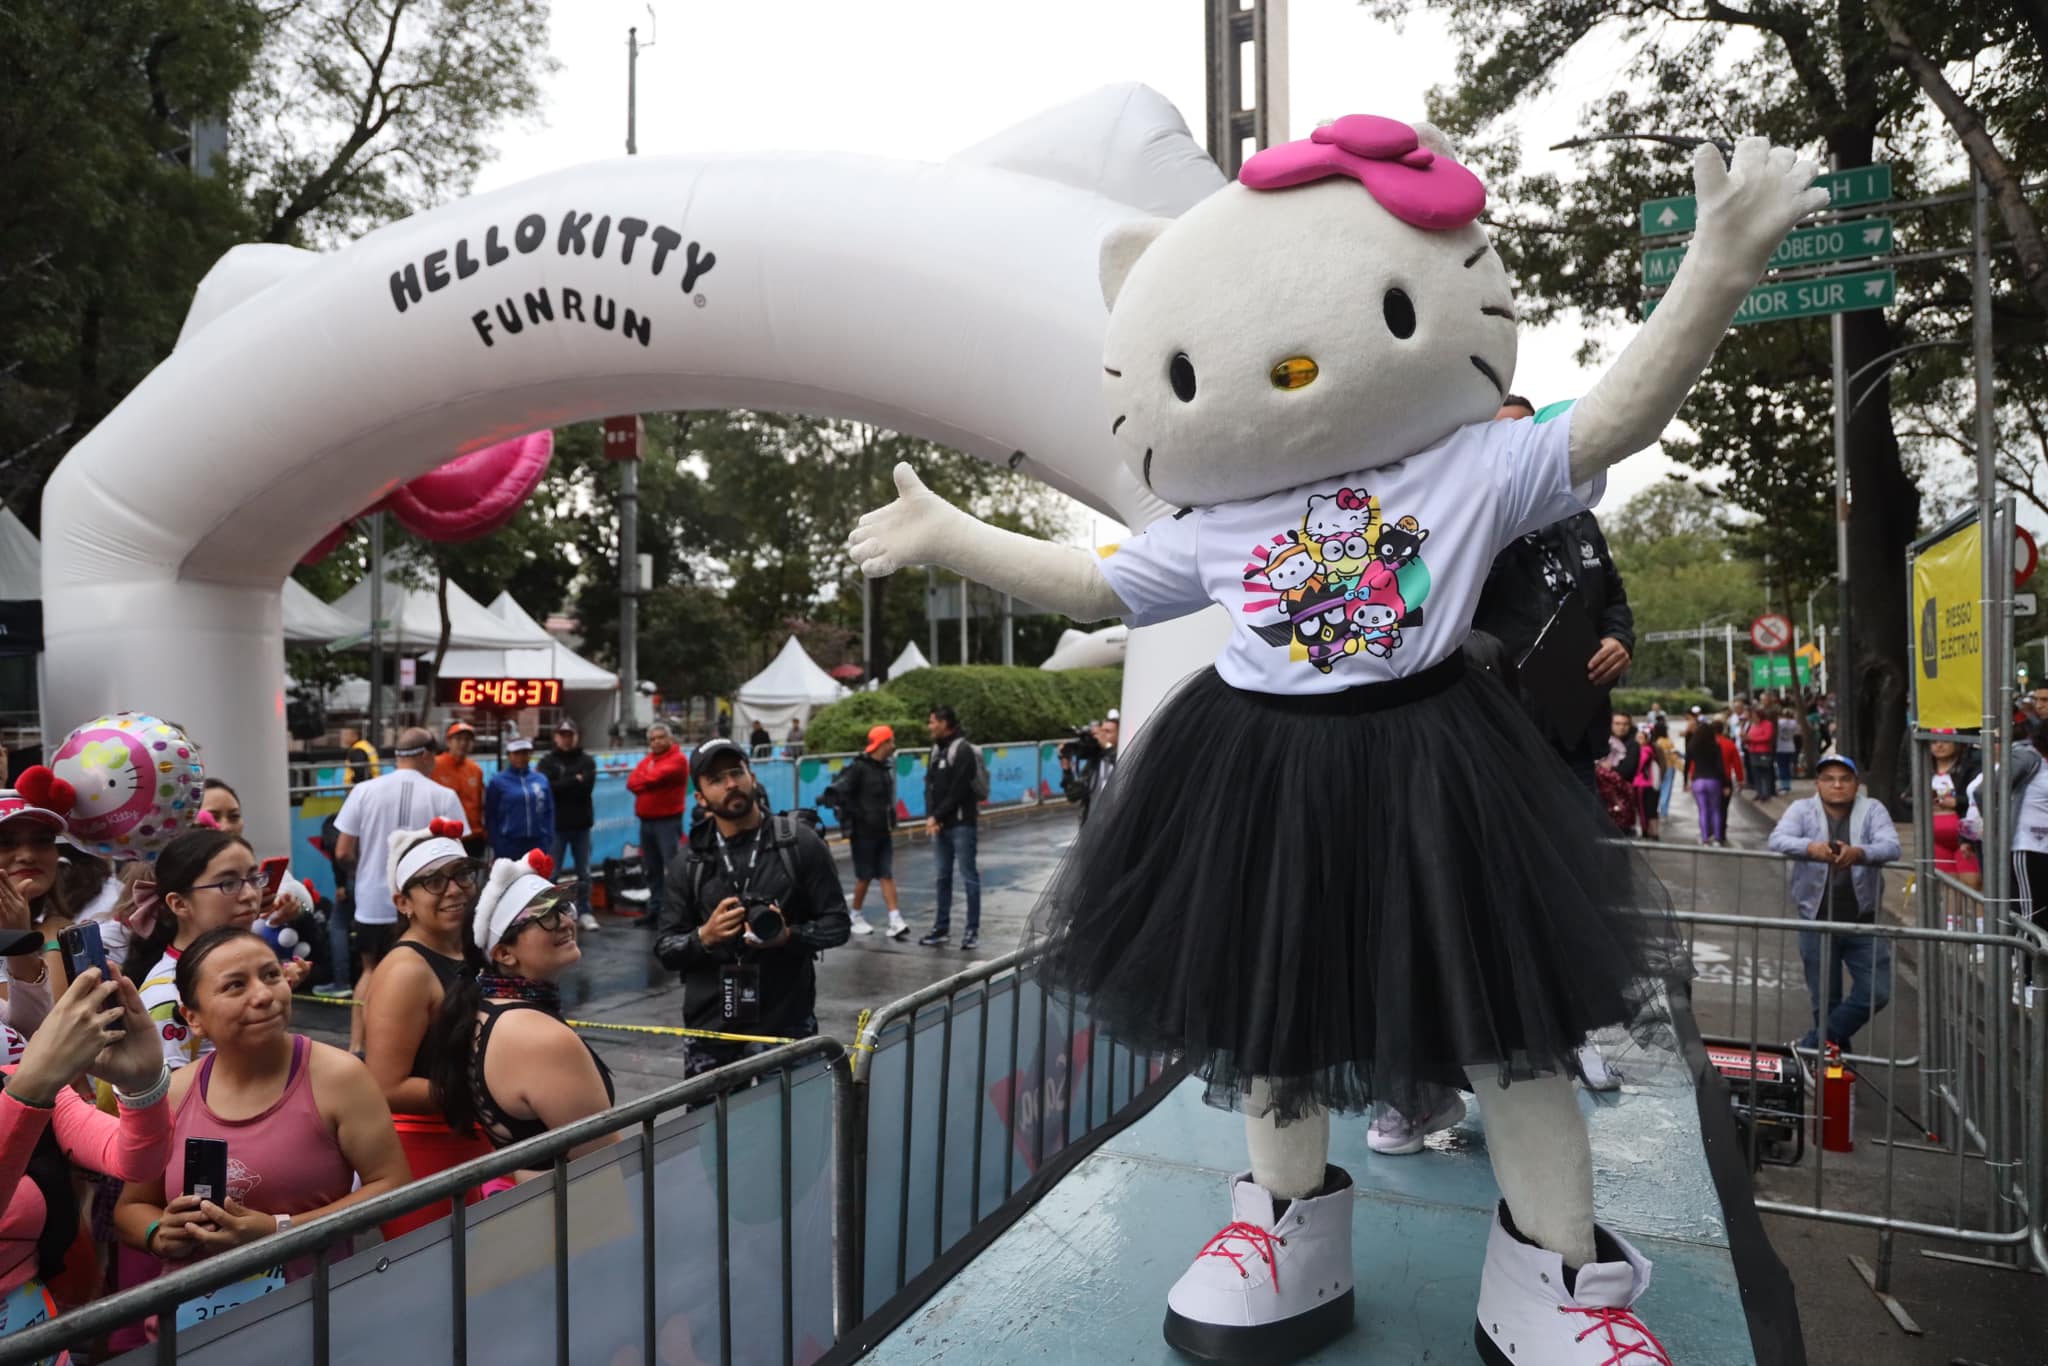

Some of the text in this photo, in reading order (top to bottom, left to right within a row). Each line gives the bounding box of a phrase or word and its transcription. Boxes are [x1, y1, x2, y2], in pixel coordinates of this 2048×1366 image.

[390, 209, 716, 313] HELLO KITTY
[471, 287, 651, 347] FUN RUN
[1797, 283, 1845, 310] SUR
